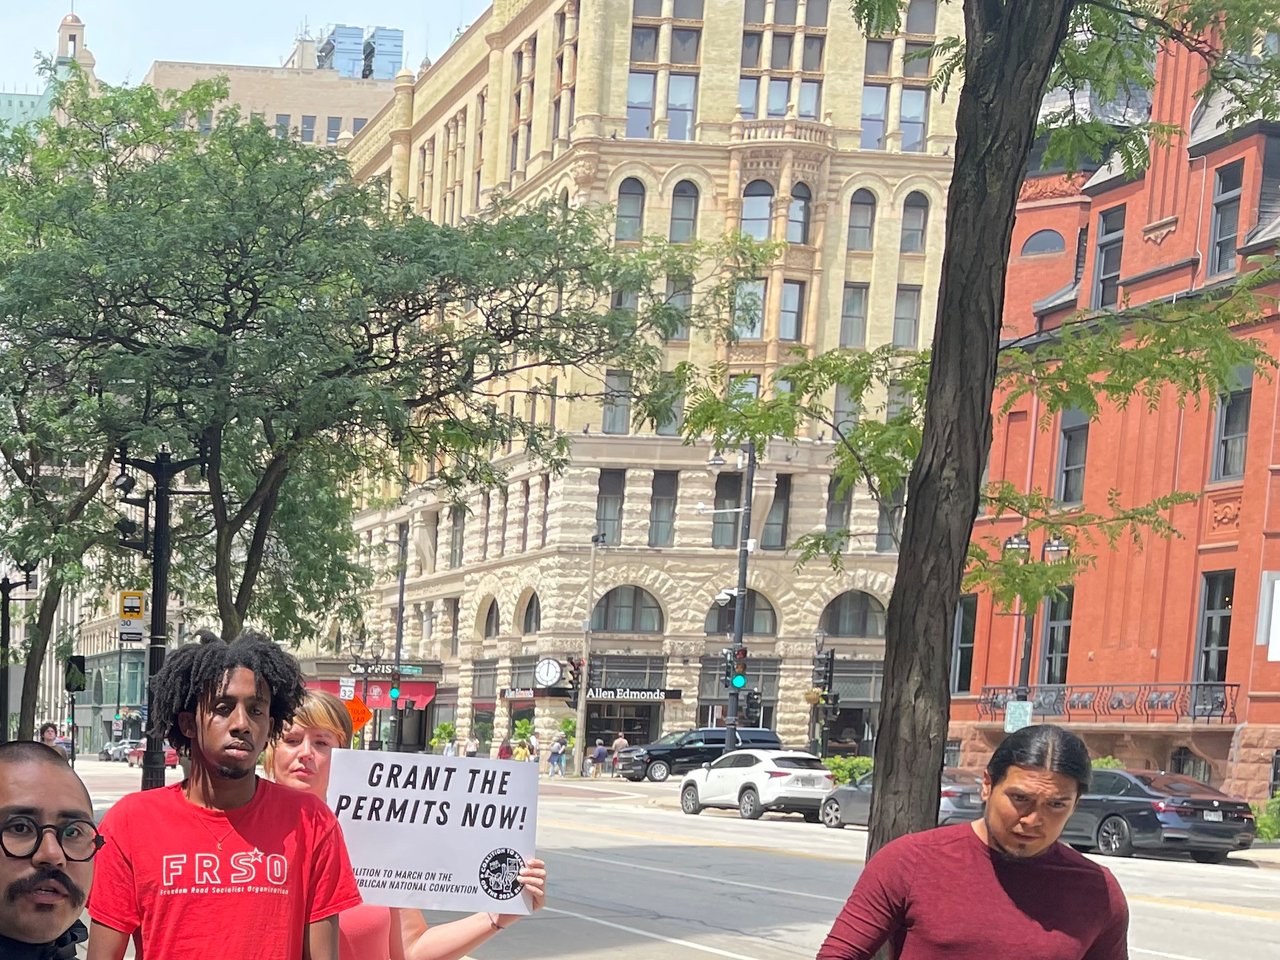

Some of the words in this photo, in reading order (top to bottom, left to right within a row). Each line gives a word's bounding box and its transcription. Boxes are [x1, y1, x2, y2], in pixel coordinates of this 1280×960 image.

[341, 690, 354, 698] 32
[586, 687, 615, 699] Allen
[616, 688, 666, 700] Edmonds
[368, 762, 457, 792] GRANT
[467, 768, 511, 796] THE
[335, 794, 451, 826] PERMITS
[461, 803, 528, 831] NOW!
[163, 850, 288, 886] FRSO
[352, 867, 381, 878] LITION
[383, 869, 393, 878] TO
[395, 870, 422, 880] MARCH
[424, 872, 436, 881] ON
[438, 872, 453, 882] THE
[356, 879, 387, 889] BLICAN
[388, 881, 427, 892] NATIONAL
[429, 883, 479, 894] CONVENTION
